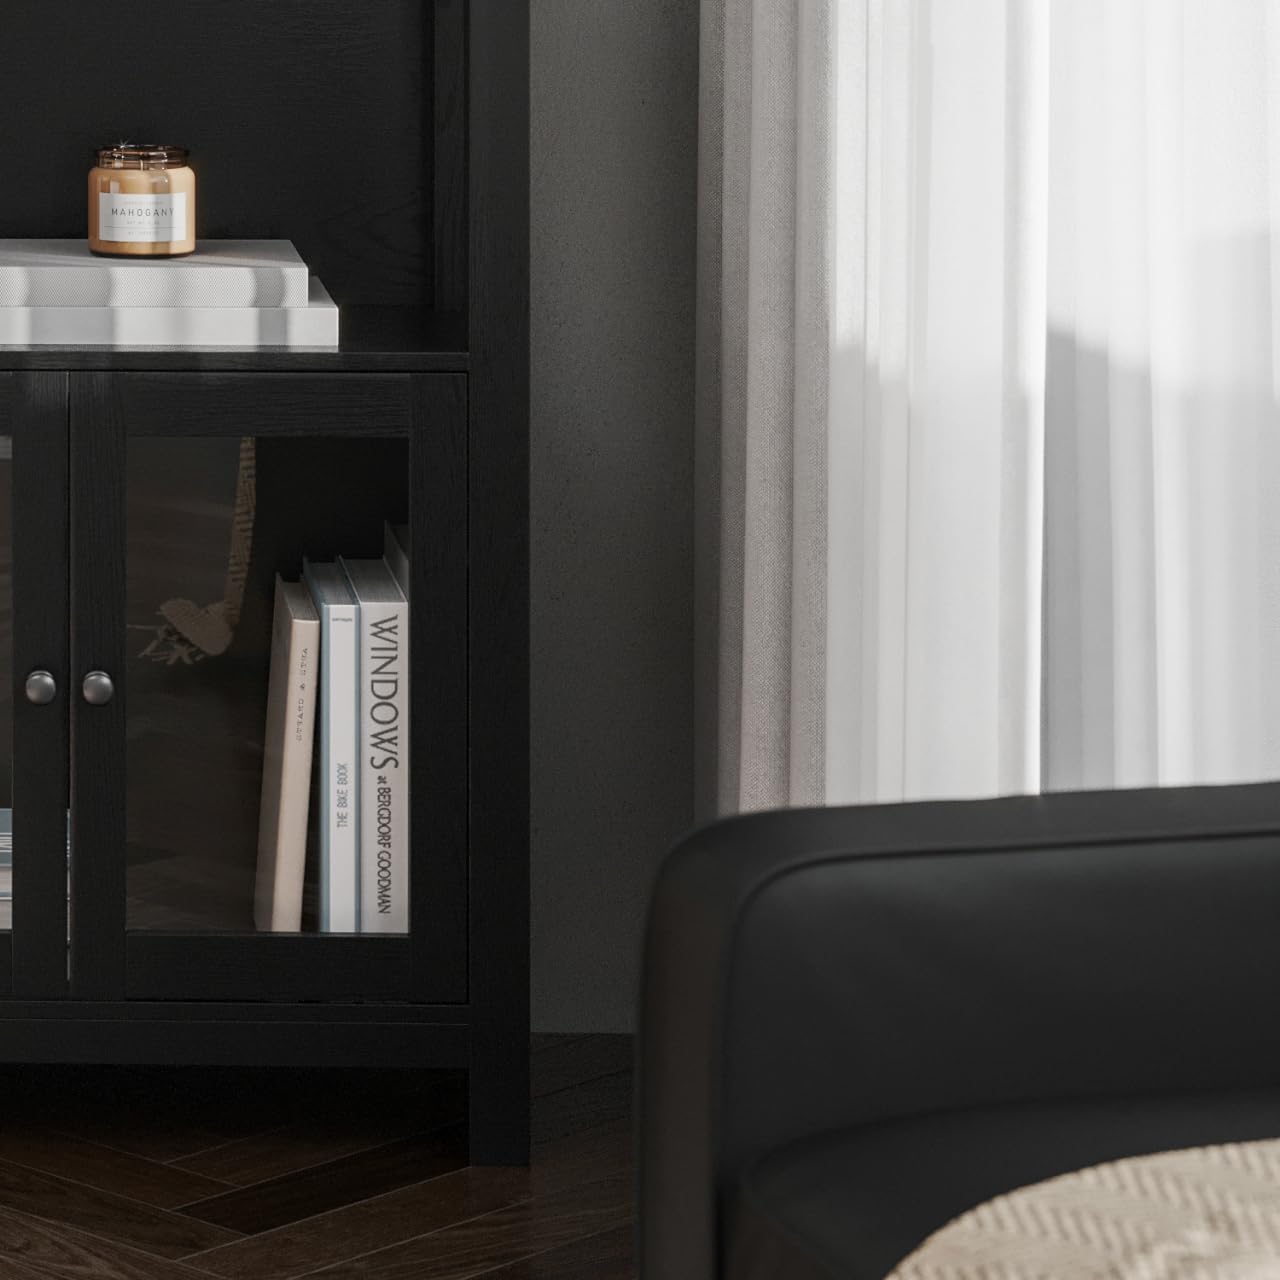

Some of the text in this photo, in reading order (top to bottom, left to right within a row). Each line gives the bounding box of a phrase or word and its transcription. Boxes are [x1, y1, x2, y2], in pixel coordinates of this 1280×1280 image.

[111, 207, 174, 217] MAHOGANY
[336, 762, 349, 828] THE BIKE BOOK
[369, 614, 400, 915] WINDOWS at BERGDORF GOODMAN
